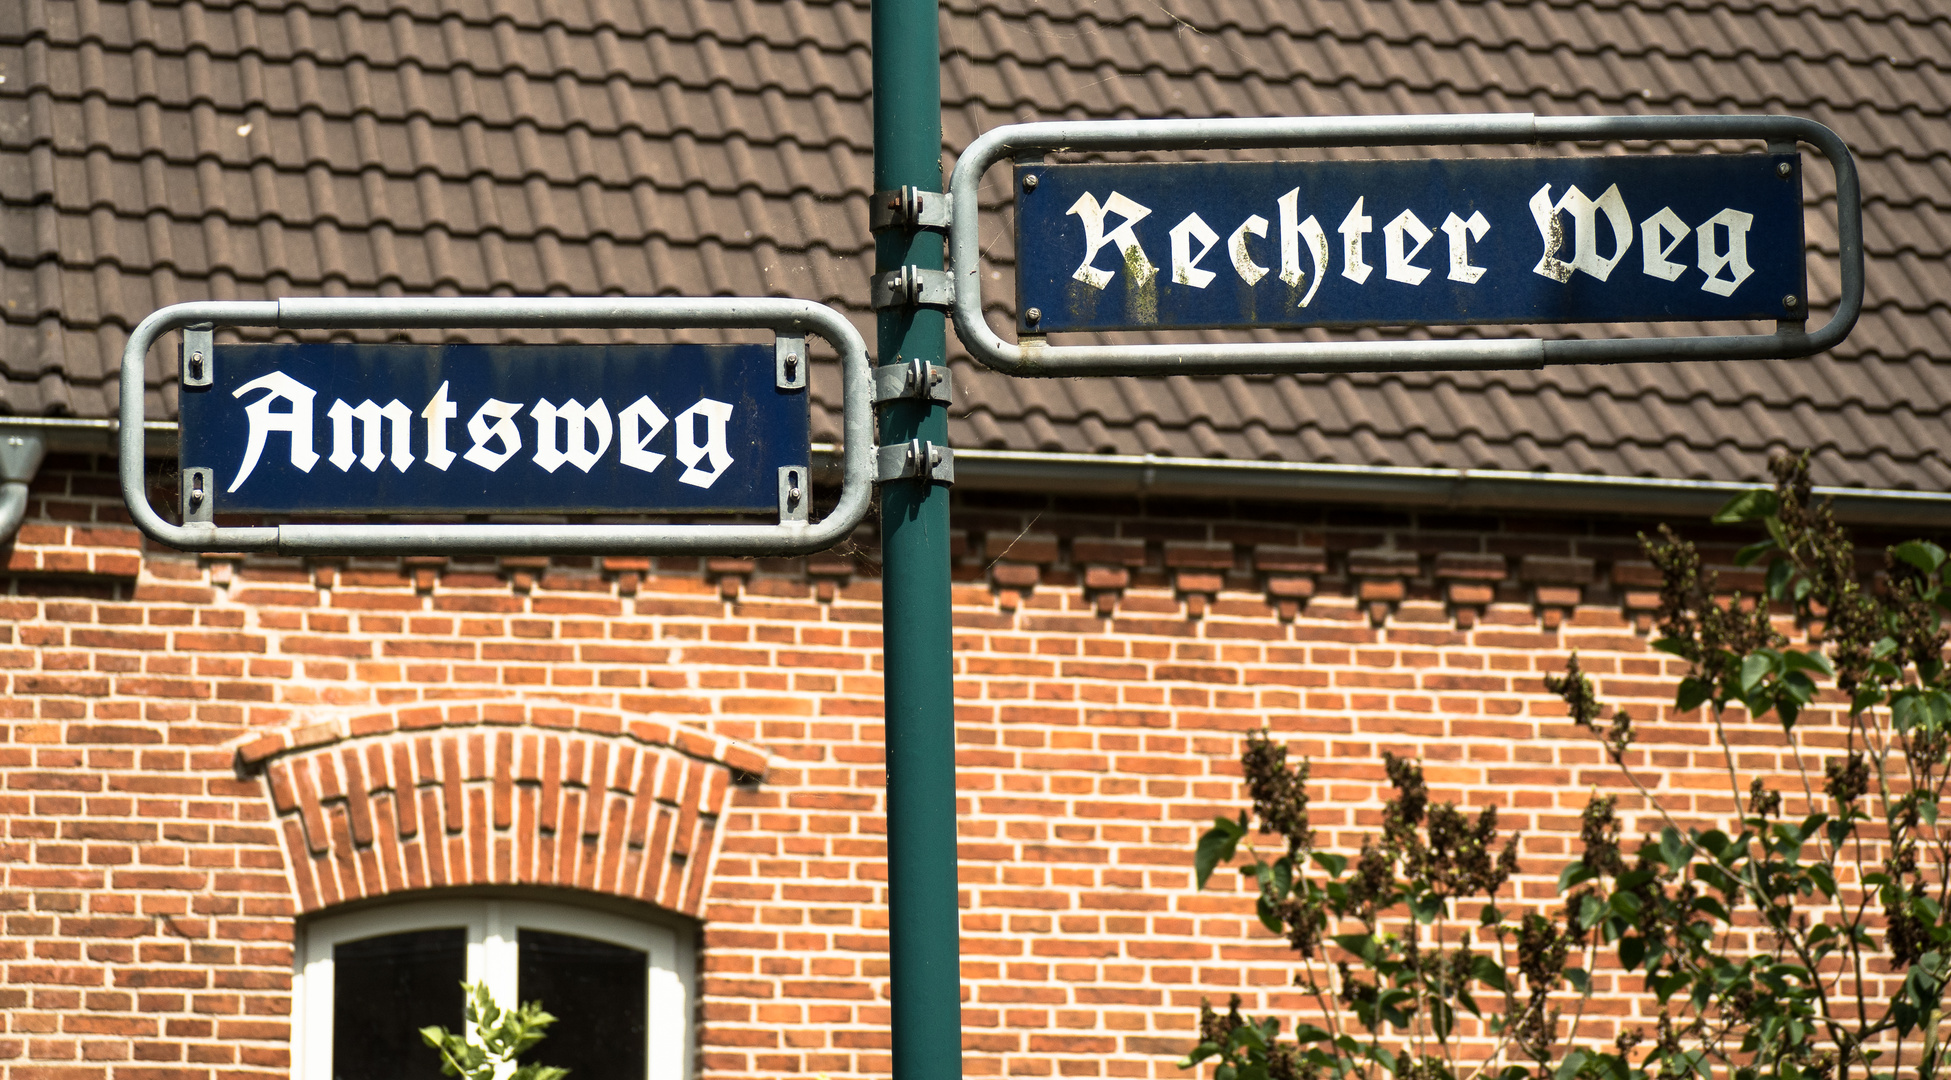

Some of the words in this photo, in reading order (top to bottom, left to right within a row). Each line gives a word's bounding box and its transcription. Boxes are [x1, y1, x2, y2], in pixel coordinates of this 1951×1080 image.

[1066, 186, 1491, 308] Rechter
[1529, 183, 1755, 298] Weg
[227, 371, 735, 493] Amtsweg
